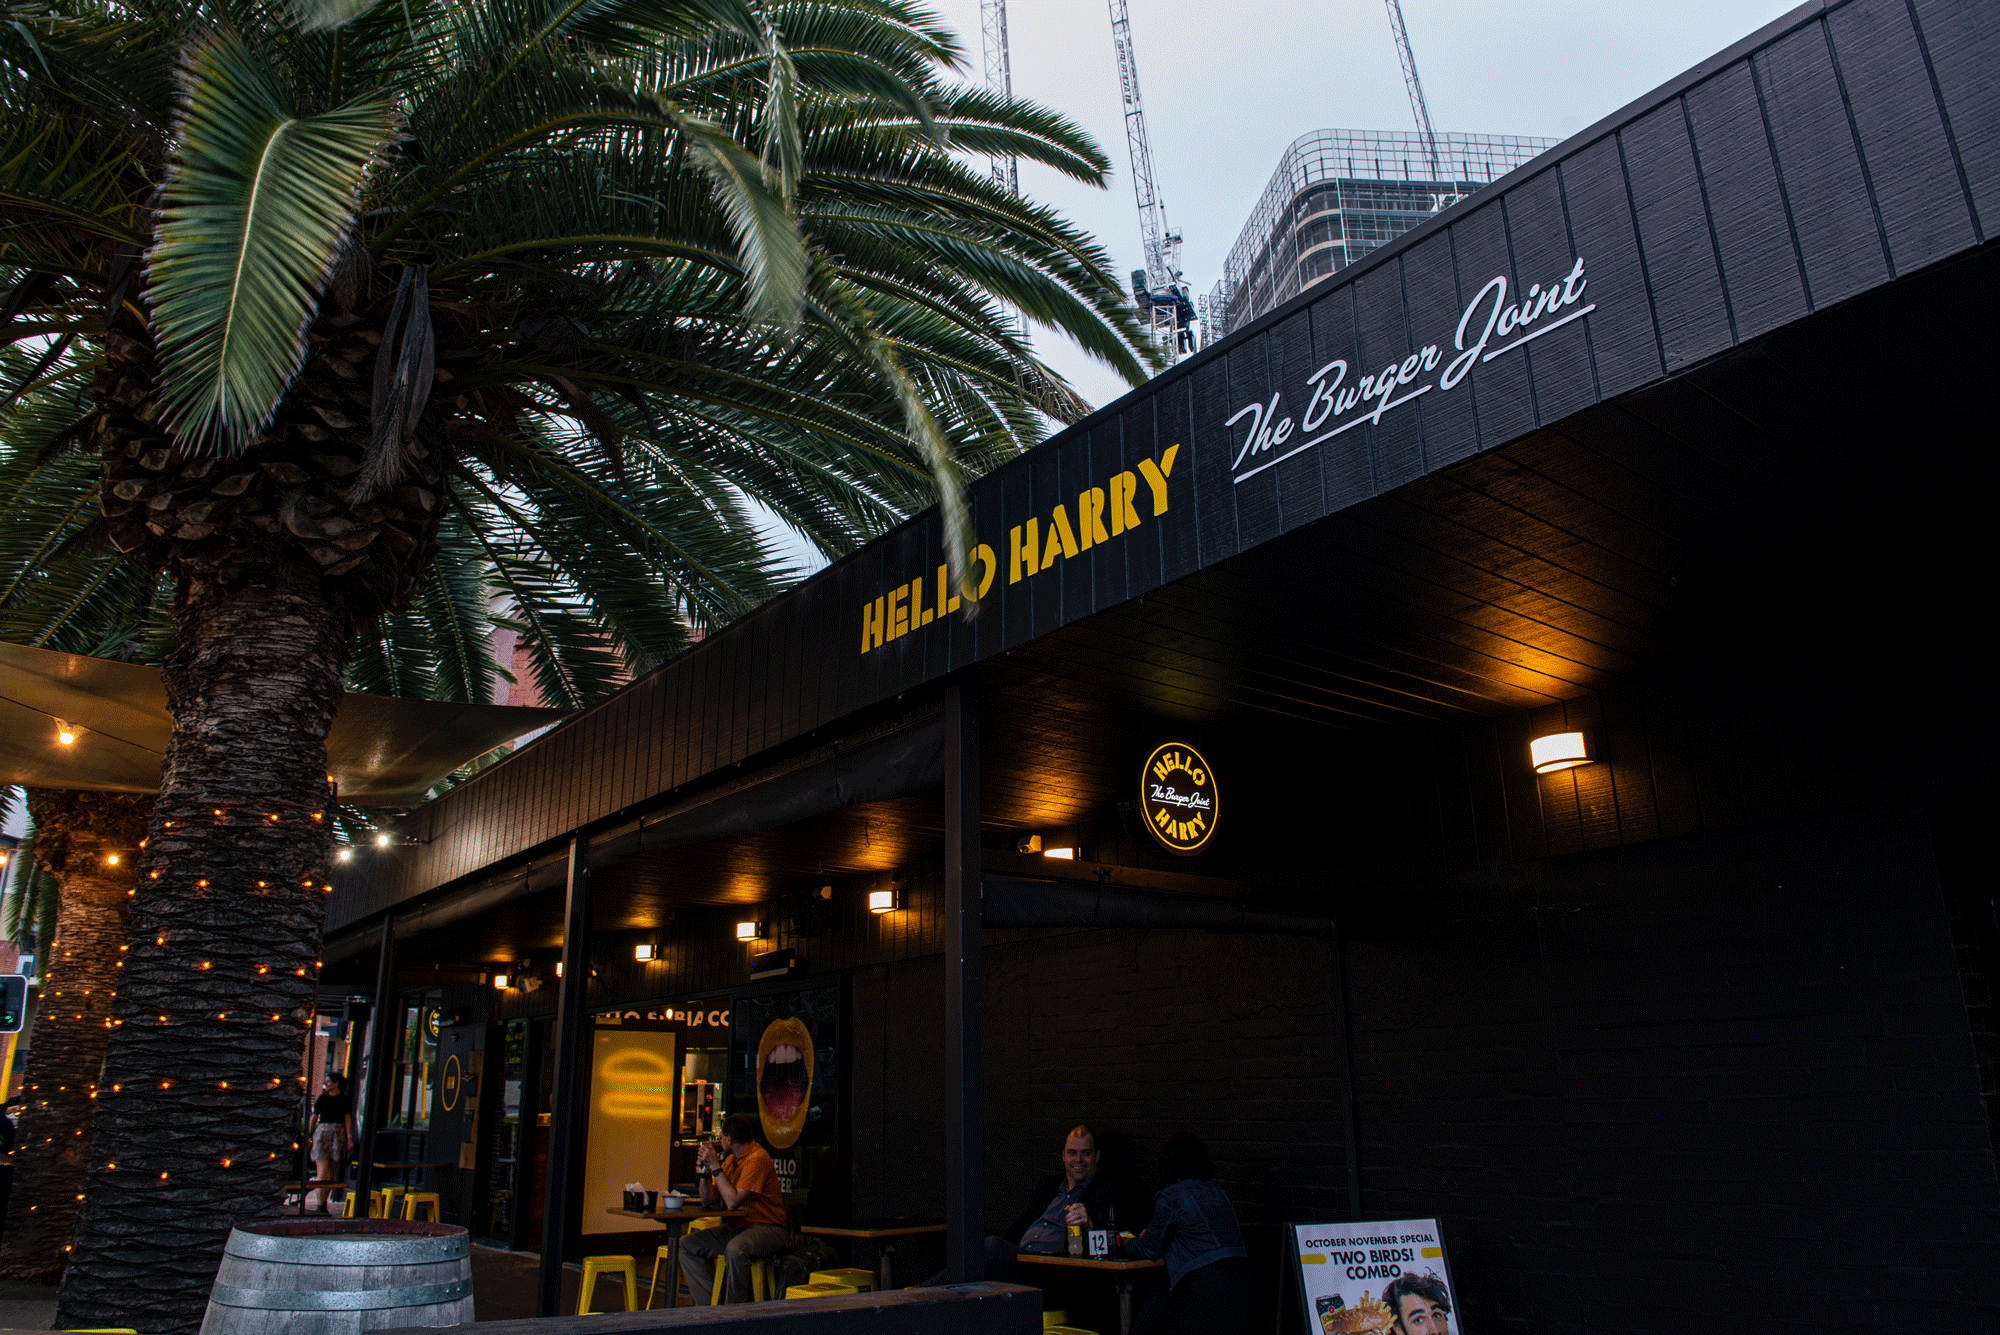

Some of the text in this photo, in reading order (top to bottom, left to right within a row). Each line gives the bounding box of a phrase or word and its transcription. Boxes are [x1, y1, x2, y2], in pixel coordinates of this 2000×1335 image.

[1225, 257, 1587, 471] The Burger Joint
[861, 443, 1180, 654] HELLO HARRY
[1153, 751, 1206, 786] HELLO
[1150, 784, 1210, 808] The Burger Joint
[1155, 807, 1206, 840] HARRY
[771, 1158, 797, 1176] ELLO
[1092, 1234, 1105, 1251] 12
[1305, 1234, 1435, 1248] OCTOBER NOVEMBER SPECIAL
[1331, 1248, 1415, 1265] TWO BIRDS!
[1346, 1264, 1401, 1280] COMBO
